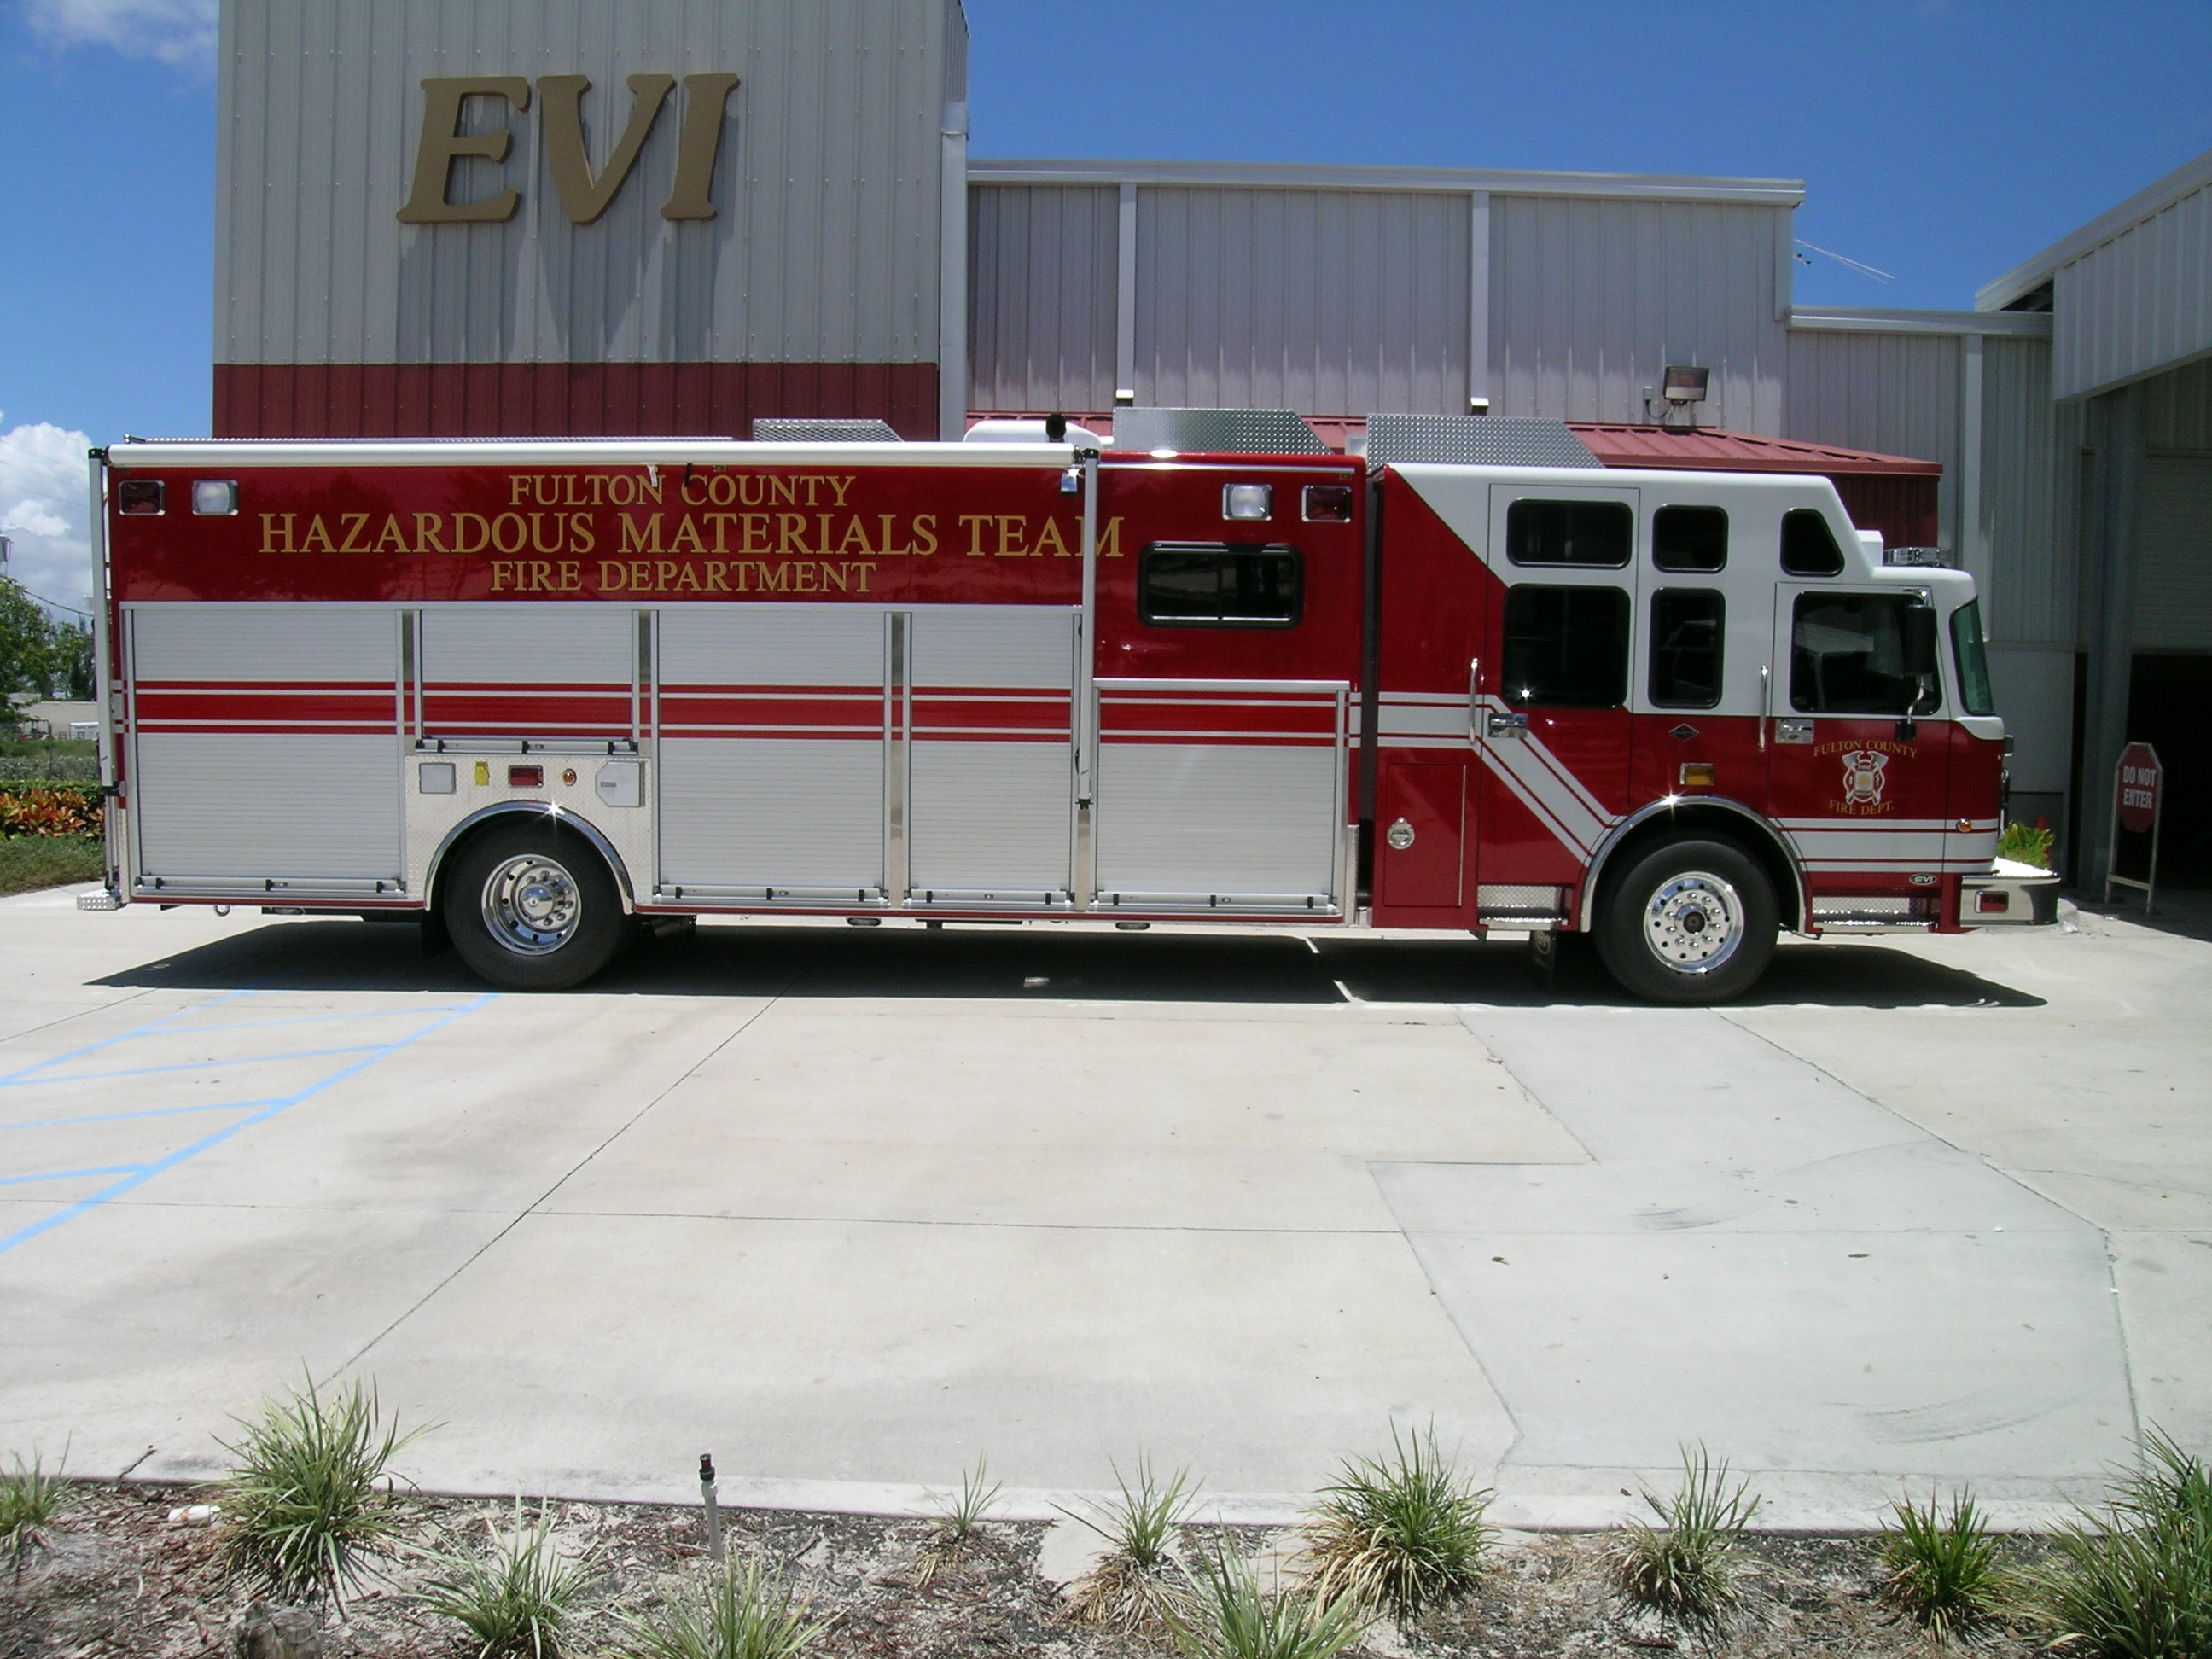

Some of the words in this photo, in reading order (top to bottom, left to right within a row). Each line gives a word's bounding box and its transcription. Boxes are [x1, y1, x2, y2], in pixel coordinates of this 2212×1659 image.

[396, 73, 740, 224] EVI
[509, 474, 666, 506] FULTON
[682, 474, 856, 506] COUNTY
[258, 512, 596, 554] HAZARDOUS
[617, 512, 938, 556] MATERIALS
[958, 515, 1125, 557] TEAM
[490, 560, 582, 592] FIRE
[597, 561, 876, 593] DEPARTMENT
[1813, 740, 1862, 757] FULTON
[1866, 740, 1918, 759] COUNTY
[2122, 765, 2136, 784] DO
[2137, 768, 2157, 787] NOT
[1829, 800, 1856, 816] FIRE
[1861, 800, 1895, 816] DEPT.
[2122, 788, 2153, 809] ENTER
